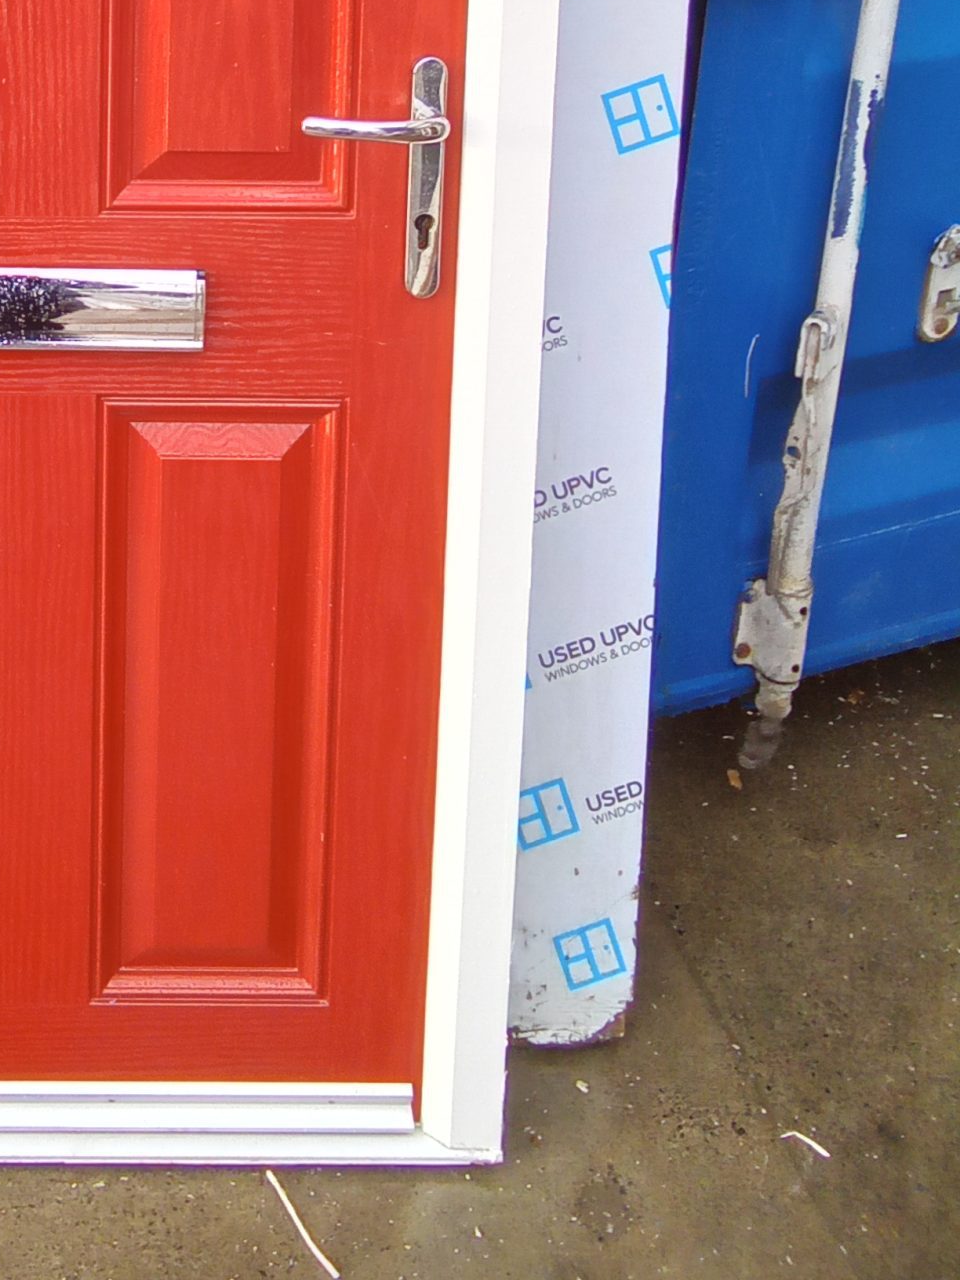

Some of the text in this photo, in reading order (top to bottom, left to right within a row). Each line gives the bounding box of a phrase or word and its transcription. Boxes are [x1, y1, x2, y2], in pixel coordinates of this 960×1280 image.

[542, 335, 568, 351] ORS
[551, 467, 612, 499] UPVC
[561, 485, 617, 513] & DOORS
[538, 637, 596, 668] USED
[544, 636, 653, 682] WINDOWS & DOO
[585, 781, 643, 812] USED
[591, 800, 644, 825] WINDOW
